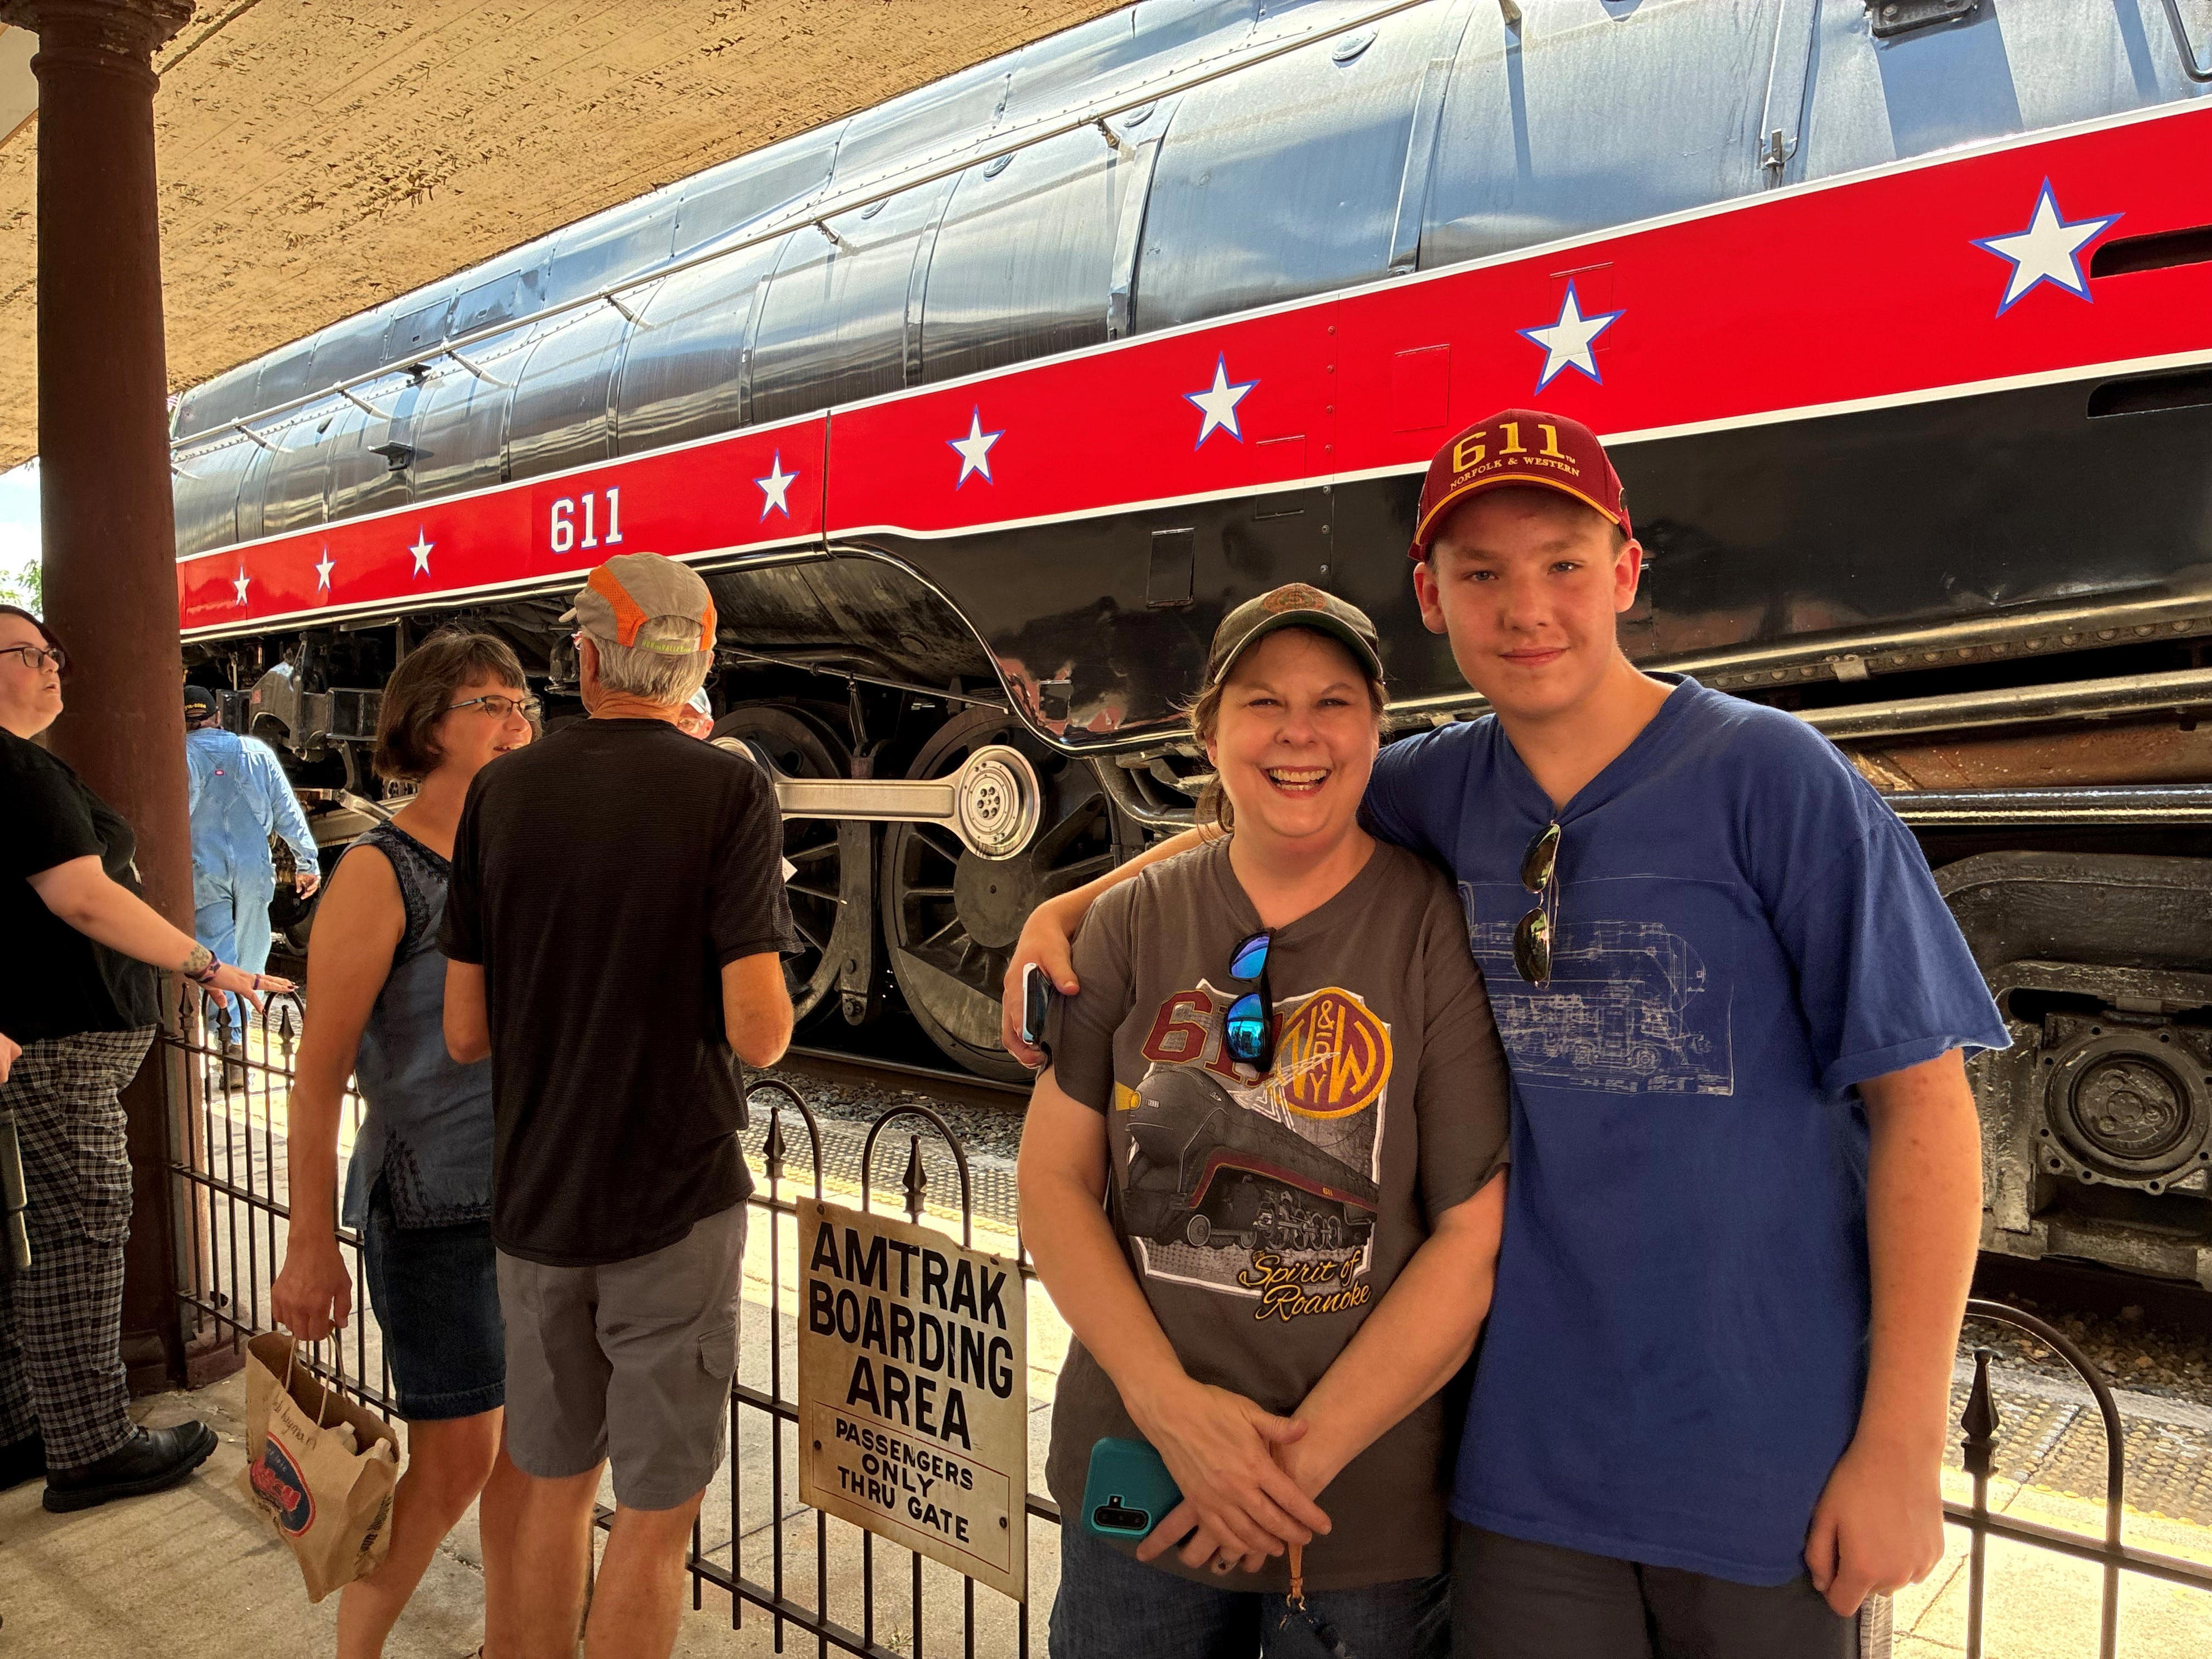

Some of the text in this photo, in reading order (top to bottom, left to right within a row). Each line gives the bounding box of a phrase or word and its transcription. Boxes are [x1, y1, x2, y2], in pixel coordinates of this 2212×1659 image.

[1450, 456, 1580, 491] NORFOLK & WESTERN
[1453, 421, 1564, 474] 611
[550, 486, 623, 554] 611
[810, 1221, 1006, 1330] AMTRAK
[1239, 1250, 1361, 1290] Spirit of
[1255, 1280, 1371, 1322] Roanoke
[809, 1278, 1013, 1399] BOARDING
[846, 1355, 971, 1451] AREA
[836, 1417, 973, 1491] PASSENGERS
[861, 1454, 935, 1498] ONLY
[837, 1465, 970, 1544] THRU GATE
